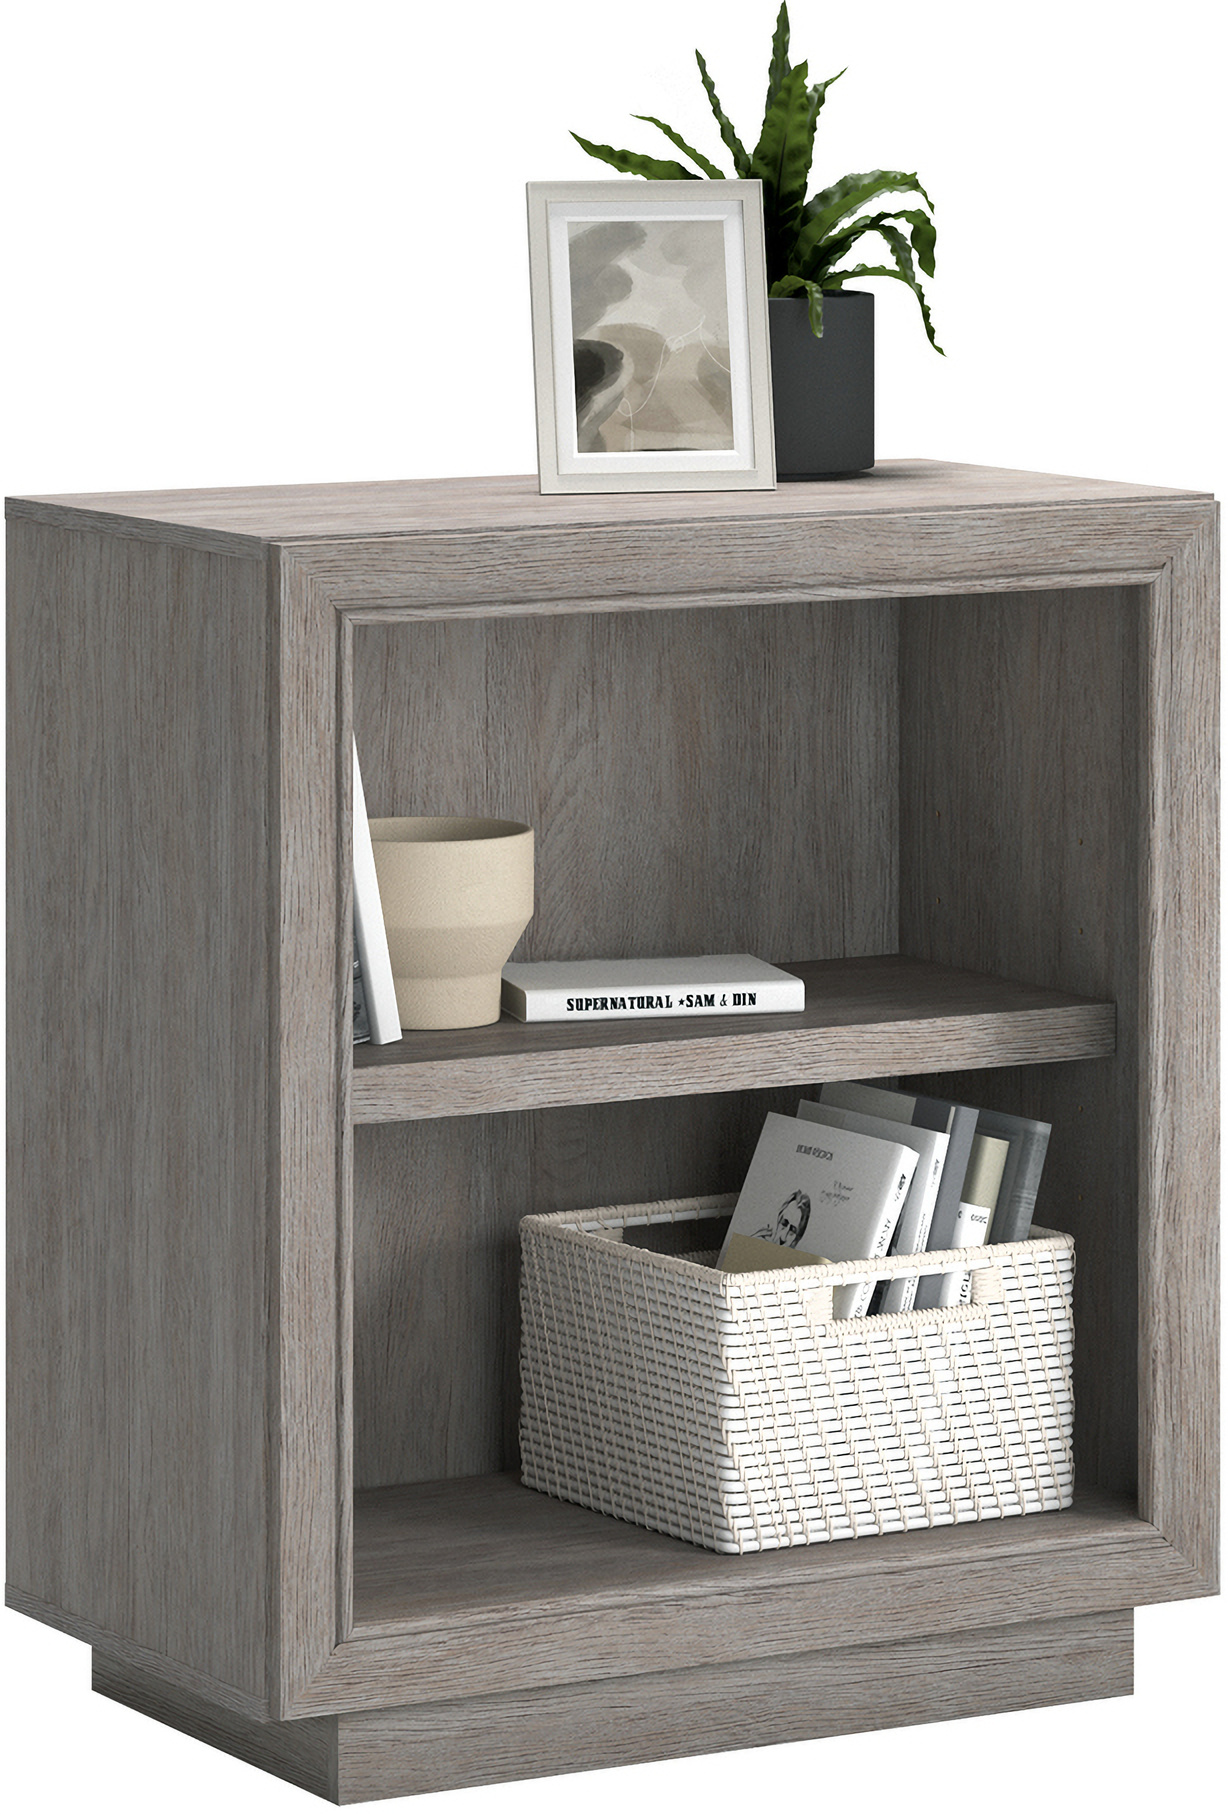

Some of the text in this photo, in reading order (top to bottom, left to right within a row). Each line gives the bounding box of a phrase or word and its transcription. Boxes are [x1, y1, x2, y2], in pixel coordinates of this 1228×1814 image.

[566, 992, 757, 1011] SUPERNATURAL SAM & DIN
